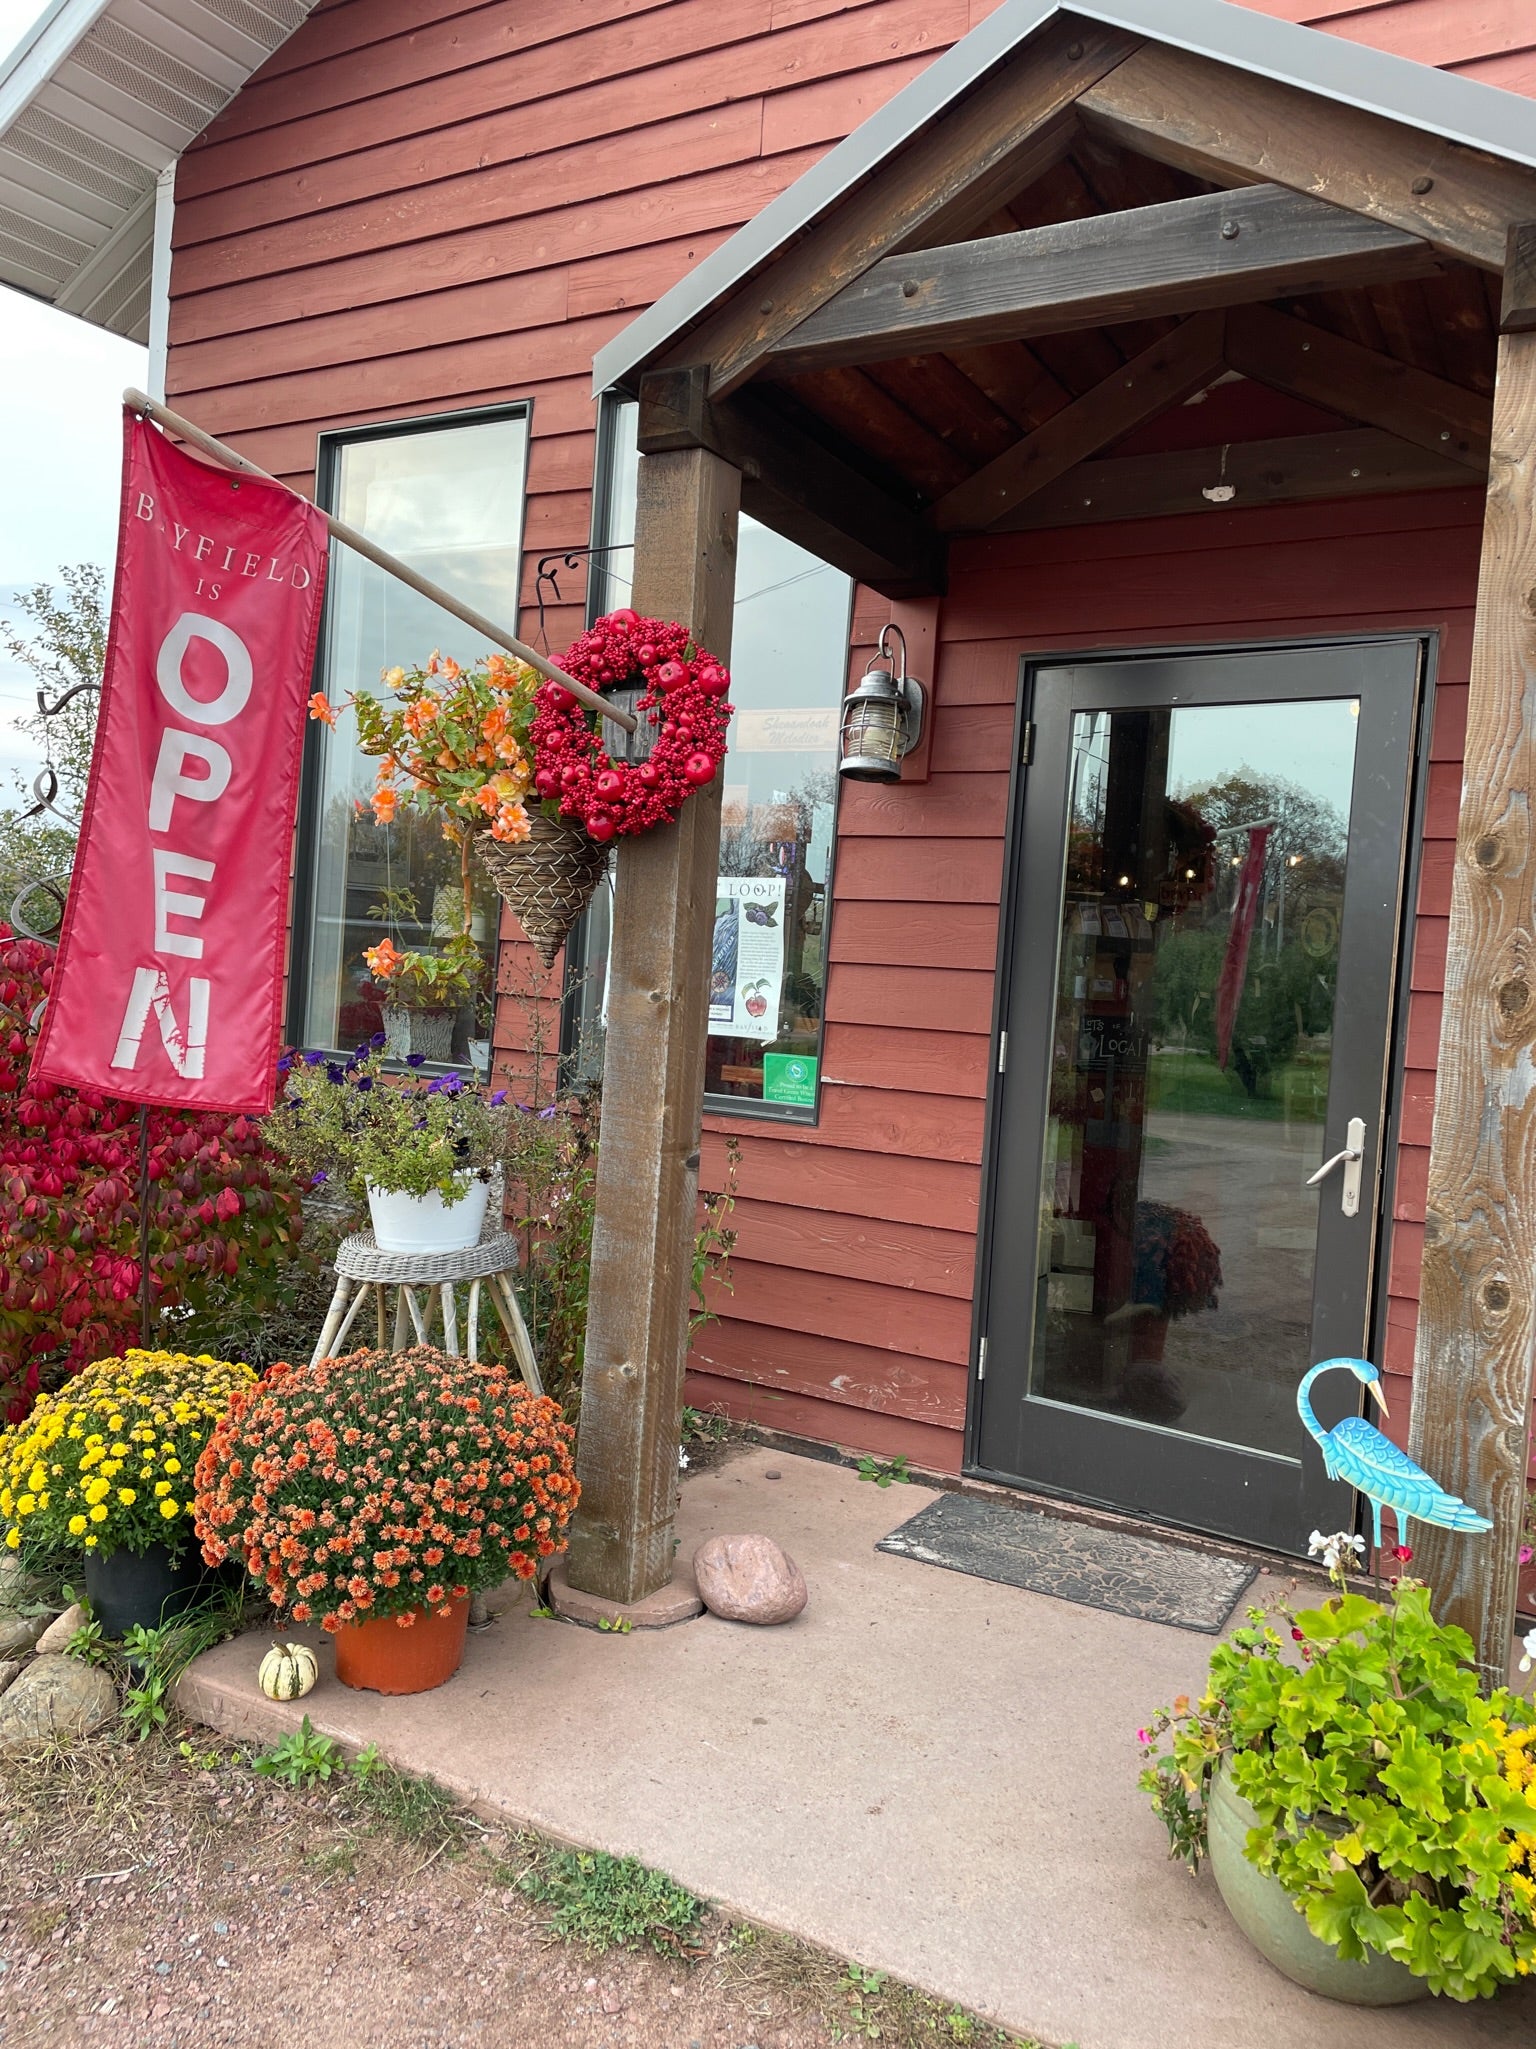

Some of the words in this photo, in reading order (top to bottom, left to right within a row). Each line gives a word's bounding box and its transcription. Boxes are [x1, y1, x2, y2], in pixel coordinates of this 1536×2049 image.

[135, 492, 311, 590] BYFIELD
[195, 578, 222, 600] IS
[110, 611, 254, 1080] OPEN
